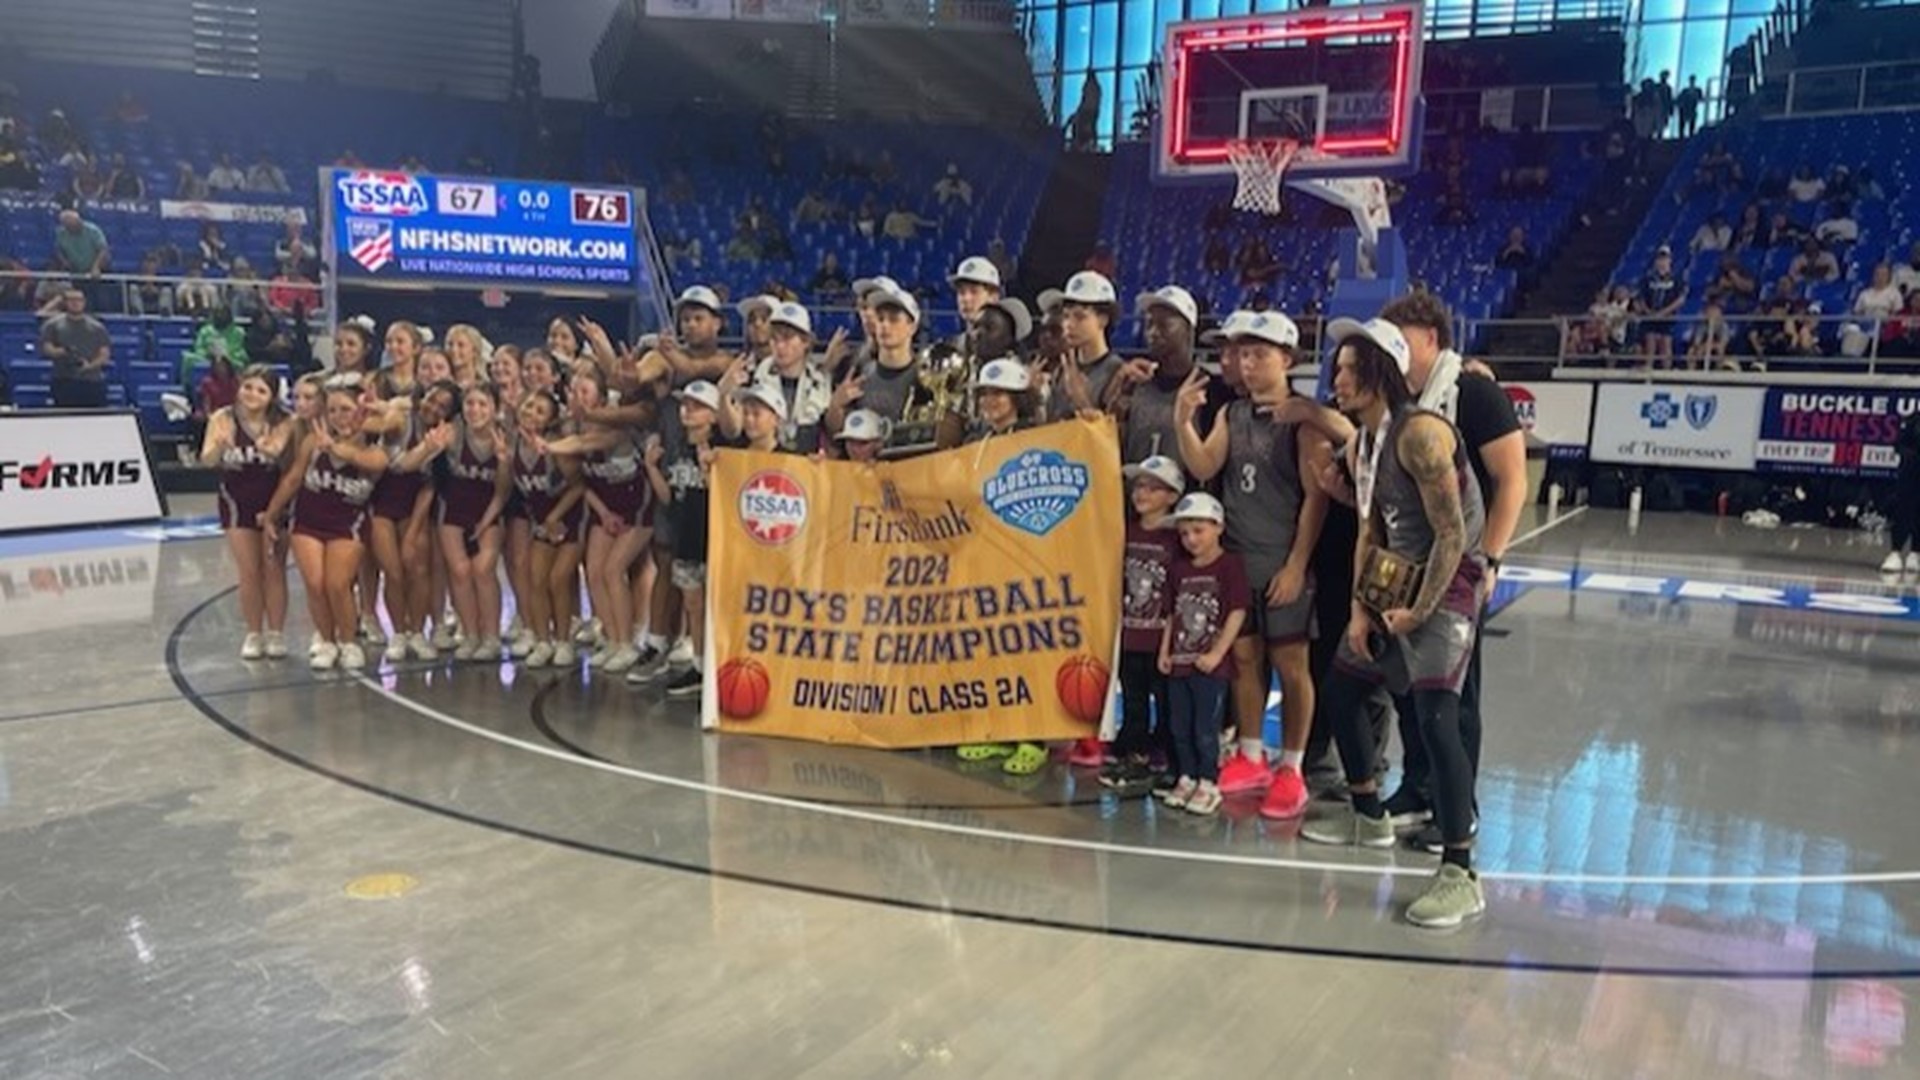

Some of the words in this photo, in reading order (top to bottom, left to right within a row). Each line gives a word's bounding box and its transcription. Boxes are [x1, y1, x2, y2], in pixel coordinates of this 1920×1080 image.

[343, 182, 425, 208] TSSAA
[450, 187, 484, 211] 67
[518, 189, 550, 209] 0.0
[583, 194, 618, 221] 76
[400, 228, 627, 261] NFHSNETWORK.COM
[401, 258, 427, 271] LIVE
[429, 260, 502, 276] NATIONWIDE
[505, 263, 535, 278] HIGH
[537, 265, 584, 281] SCHOOL
[585, 267, 630, 283] SPORTS
[1782, 393, 1889, 415] BUCKLE
[1897, 398, 1920, 416] U
[1618, 440, 1636, 456] of
[1641, 441, 1732, 460] Tennessee
[986, 464, 1086, 501] BLUECROSS
[1240, 463, 1256, 493] 3
[745, 493, 803, 518] TSSAA
[885, 553, 950, 588] 2024
[863, 572, 1085, 626] BASKETBALL
[747, 621, 863, 662] STATE
[874, 615, 1083, 665] CHAMPIONS
[794, 678, 887, 714] DIVISION
[908, 680, 989, 715] CLASS
[996, 675, 1034, 707] 2A
